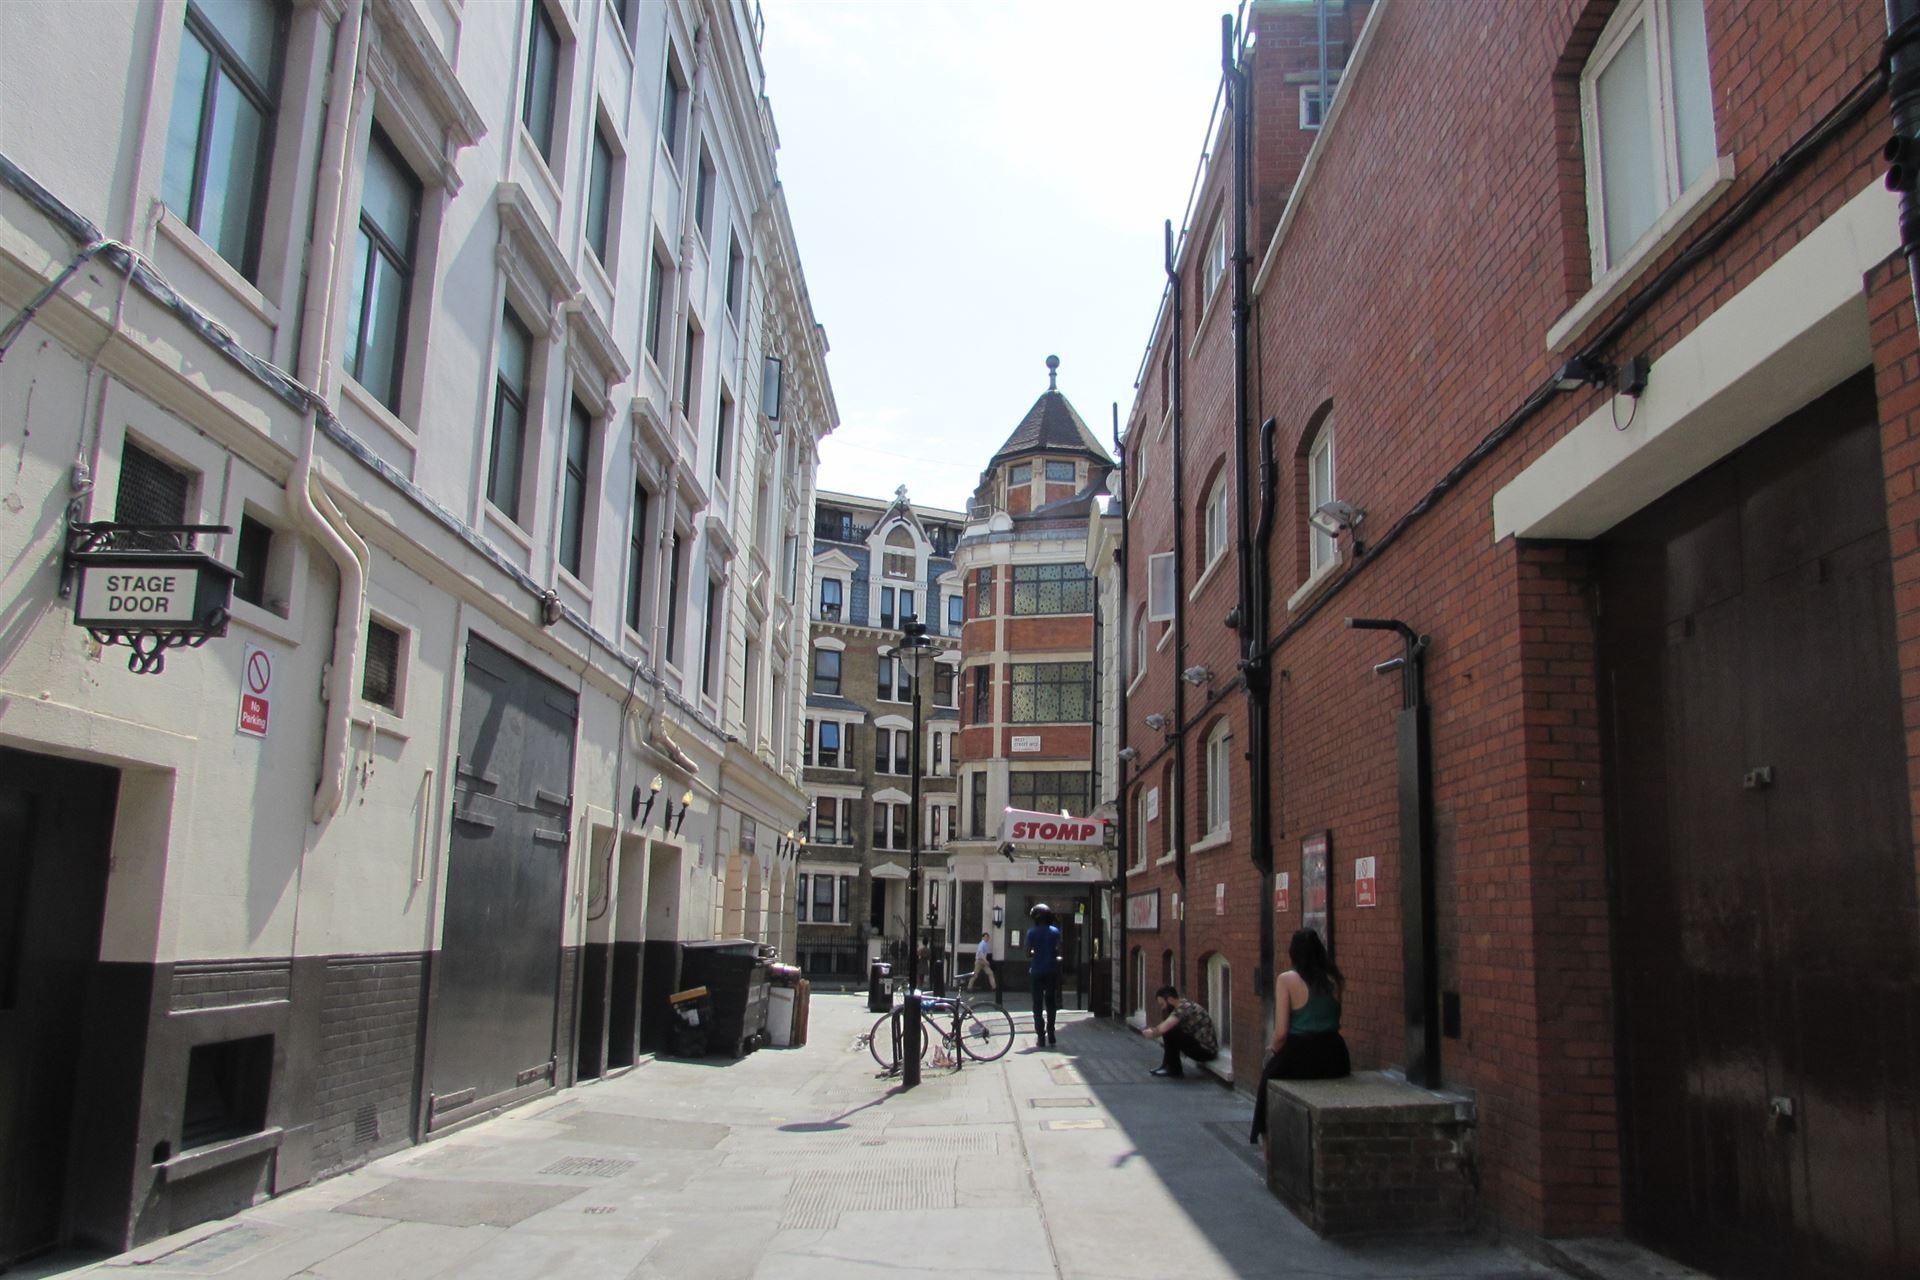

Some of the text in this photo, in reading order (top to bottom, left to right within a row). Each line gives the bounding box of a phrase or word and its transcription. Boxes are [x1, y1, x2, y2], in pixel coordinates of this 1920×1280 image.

[107, 575, 176, 592] STAGE
[109, 596, 169, 612] DOOR
[251, 700, 260, 713] No
[242, 711, 266, 729] Parking
[1012, 822, 1096, 841] STOMP
[1038, 865, 1070, 873] STOMP
